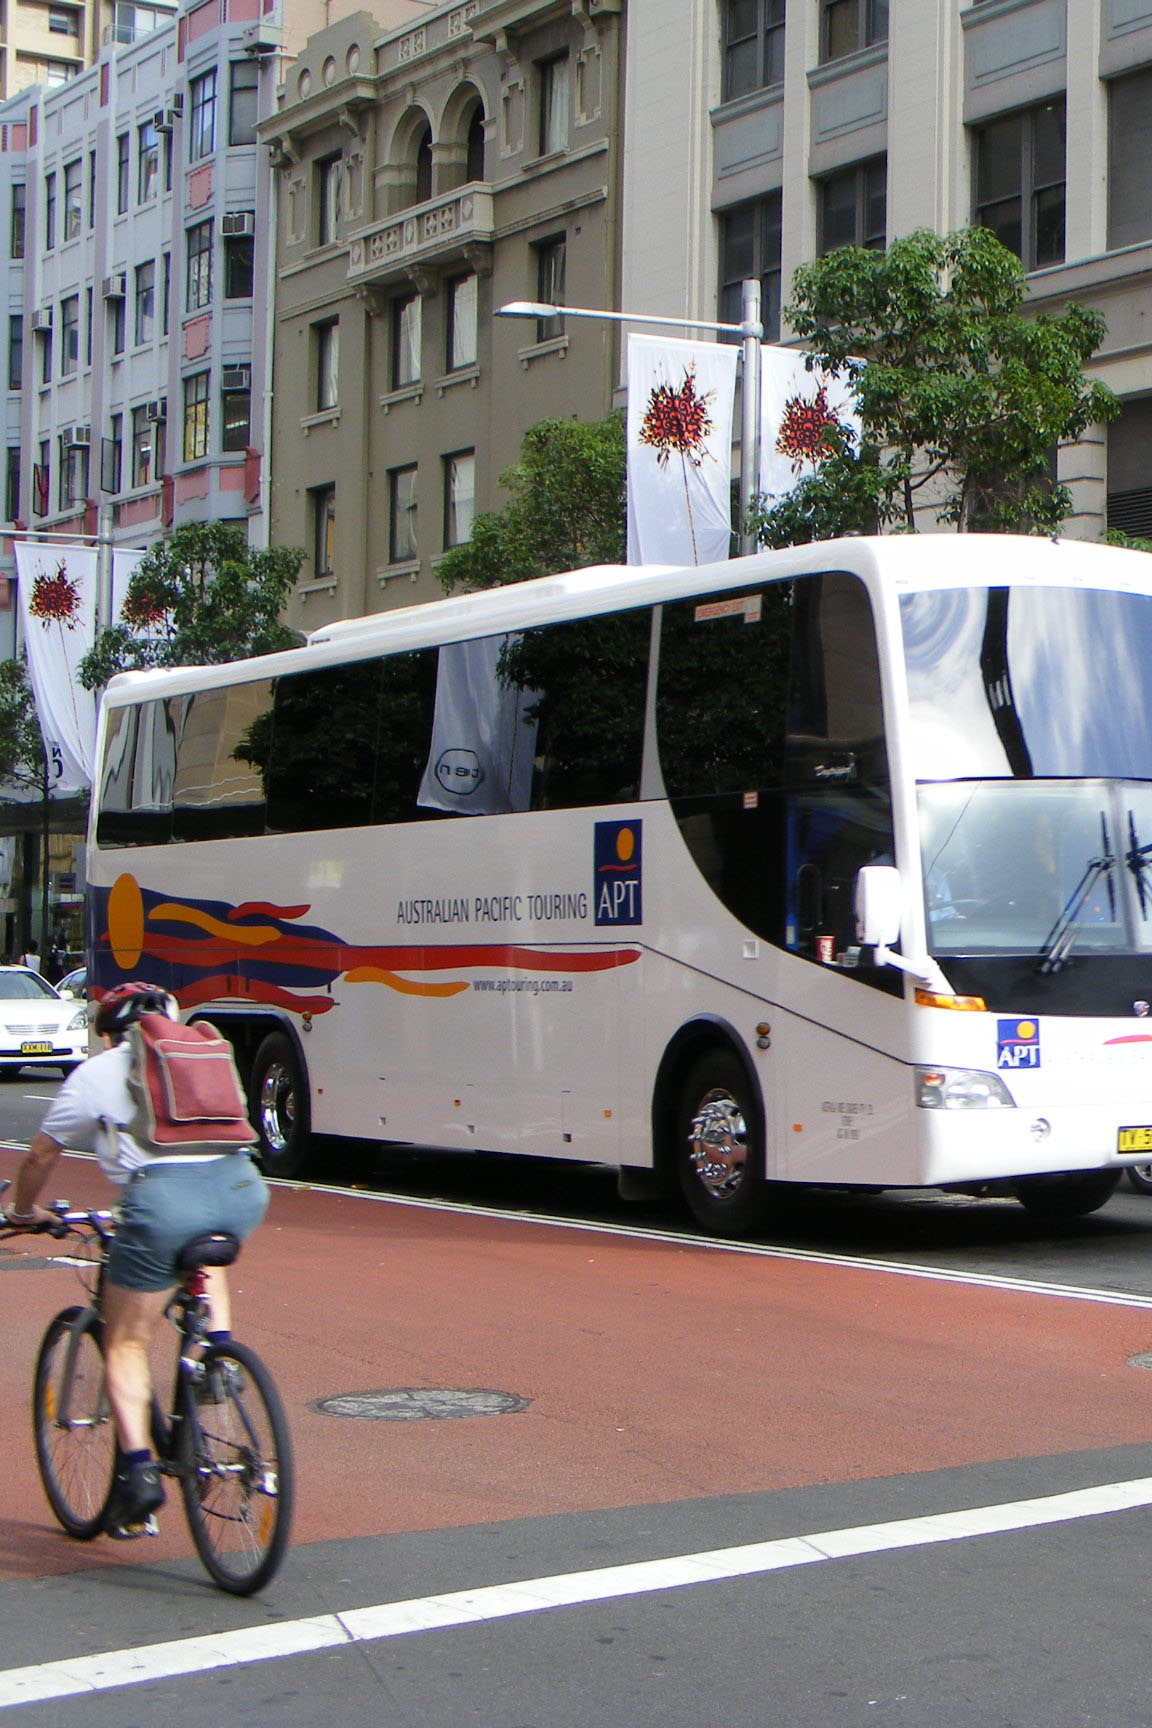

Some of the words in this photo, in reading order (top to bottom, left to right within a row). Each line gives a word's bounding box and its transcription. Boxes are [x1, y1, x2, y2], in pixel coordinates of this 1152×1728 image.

[397, 900, 469, 925] AUSTRALIAN
[475, 896, 523, 922] PACIFIC
[527, 893, 588, 921] TOURING
[597, 880, 640, 920] APT
[473, 976, 573, 996] www.aptouring.com.au
[998, 1045, 1040, 1068] APT
